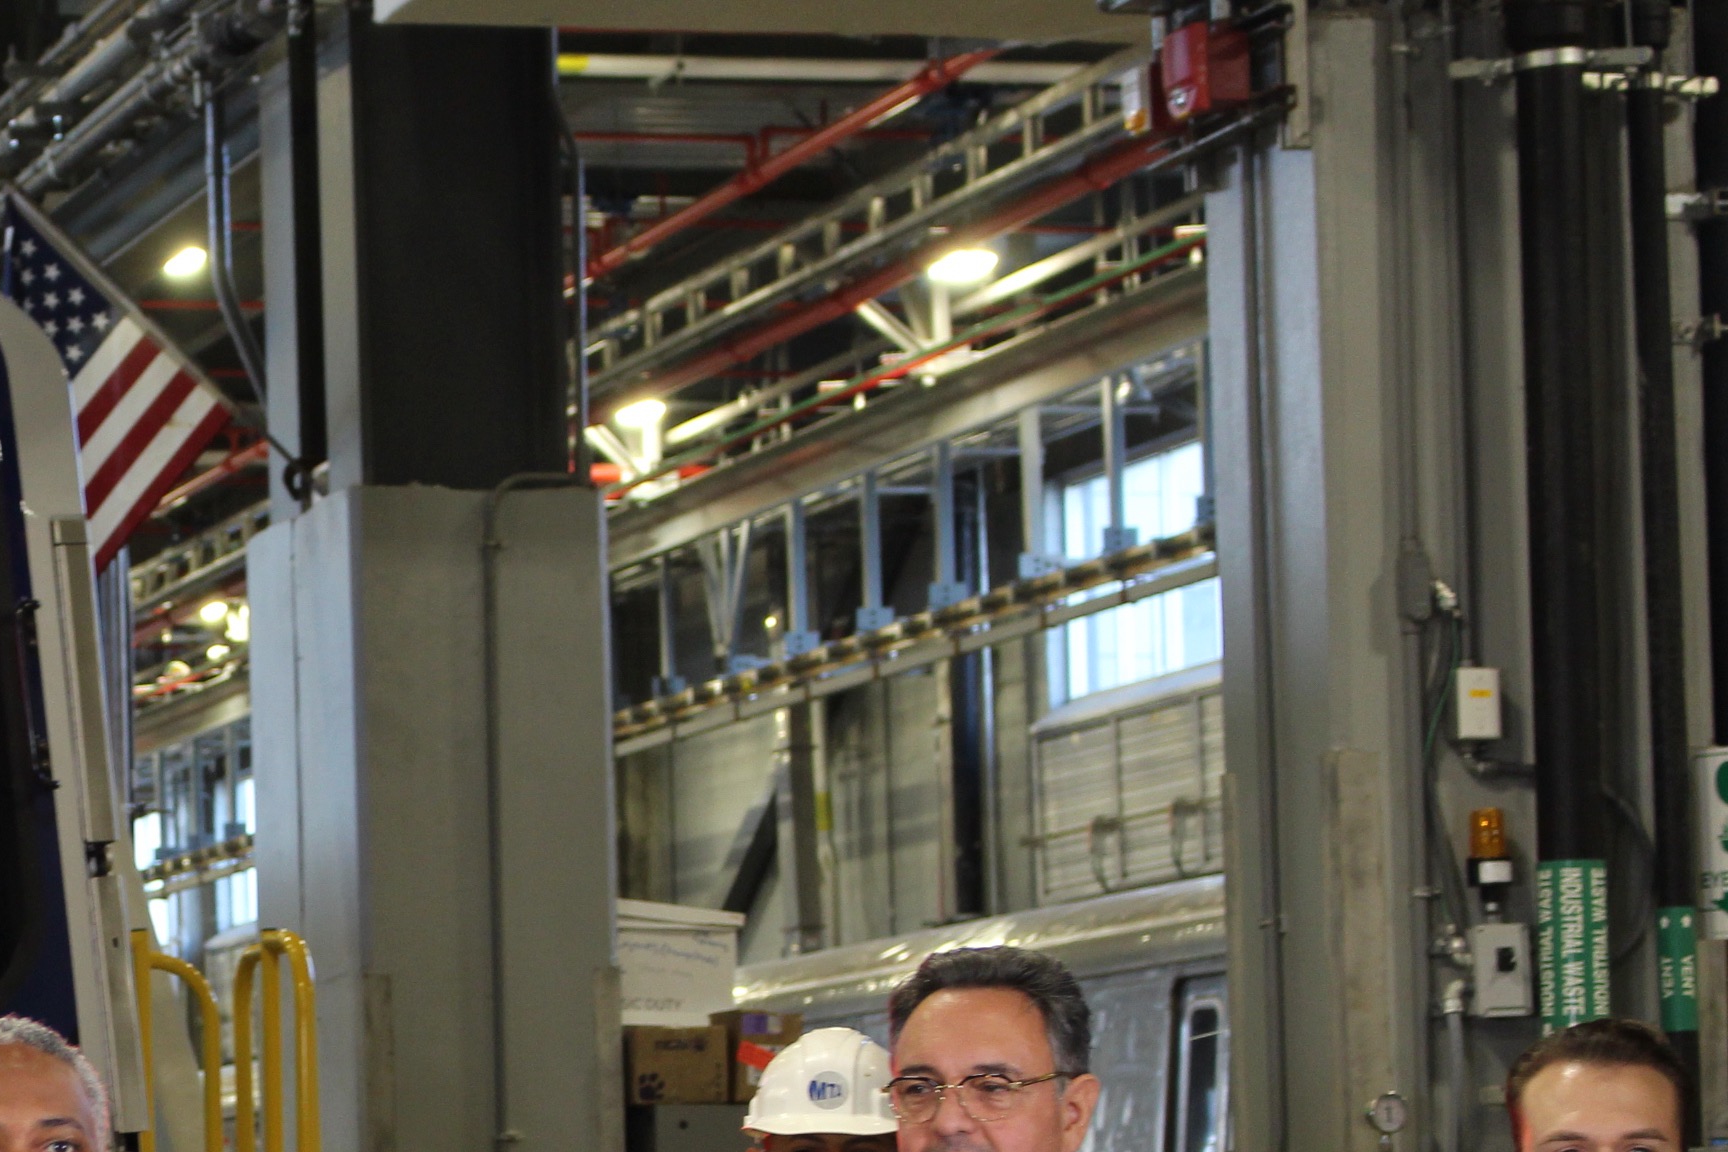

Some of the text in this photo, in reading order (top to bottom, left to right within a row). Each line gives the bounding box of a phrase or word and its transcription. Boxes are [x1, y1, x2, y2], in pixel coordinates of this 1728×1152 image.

[1537, 868, 1555, 1016] INDUSTRIAL WASTE
[1558, 867, 1586, 1016] INDUSTRIAL WASTE
[1590, 867, 1610, 1016] INDUSTRIAL WASTE
[1661, 957, 1674, 998] VENT
[1681, 954, 1694, 998] VENT
